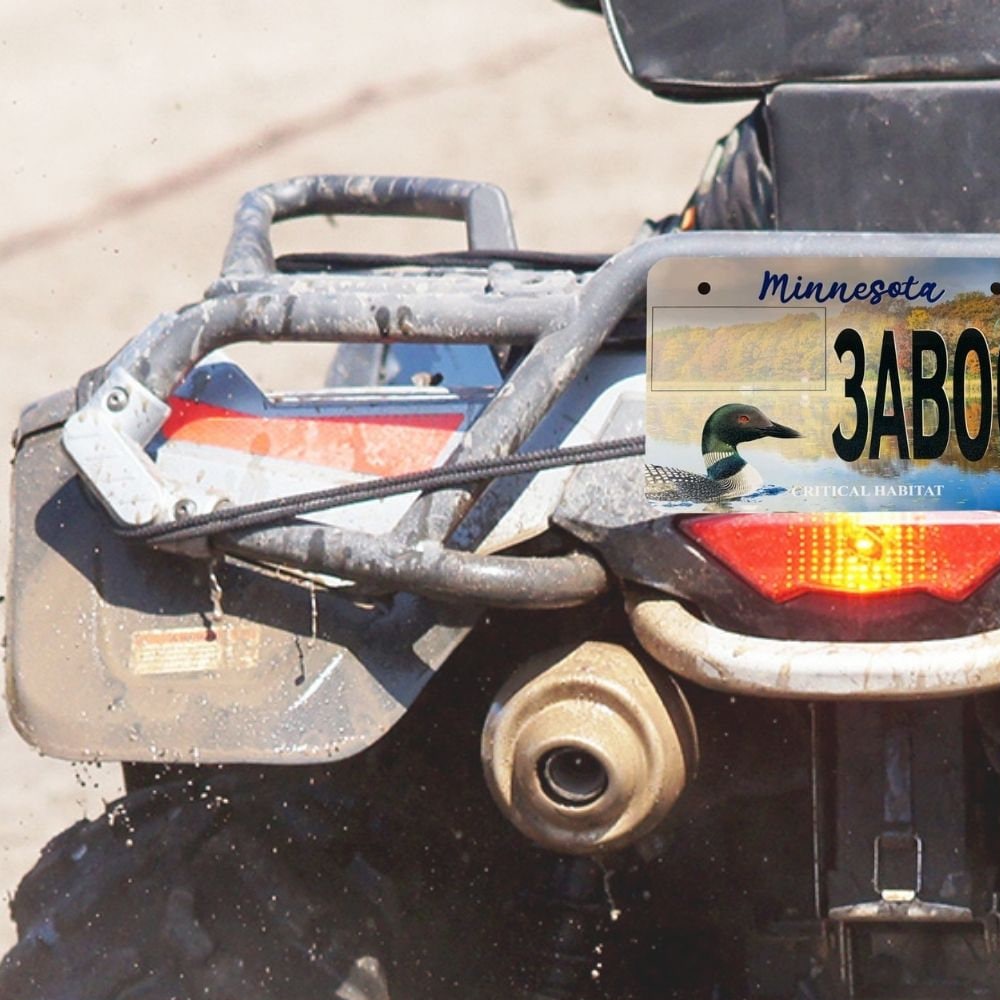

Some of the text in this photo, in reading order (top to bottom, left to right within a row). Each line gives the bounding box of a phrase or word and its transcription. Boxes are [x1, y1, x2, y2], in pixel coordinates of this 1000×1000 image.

[758, 270, 946, 305] Minnesota
[791, 484, 945, 497] CRITICAL HABITAT
